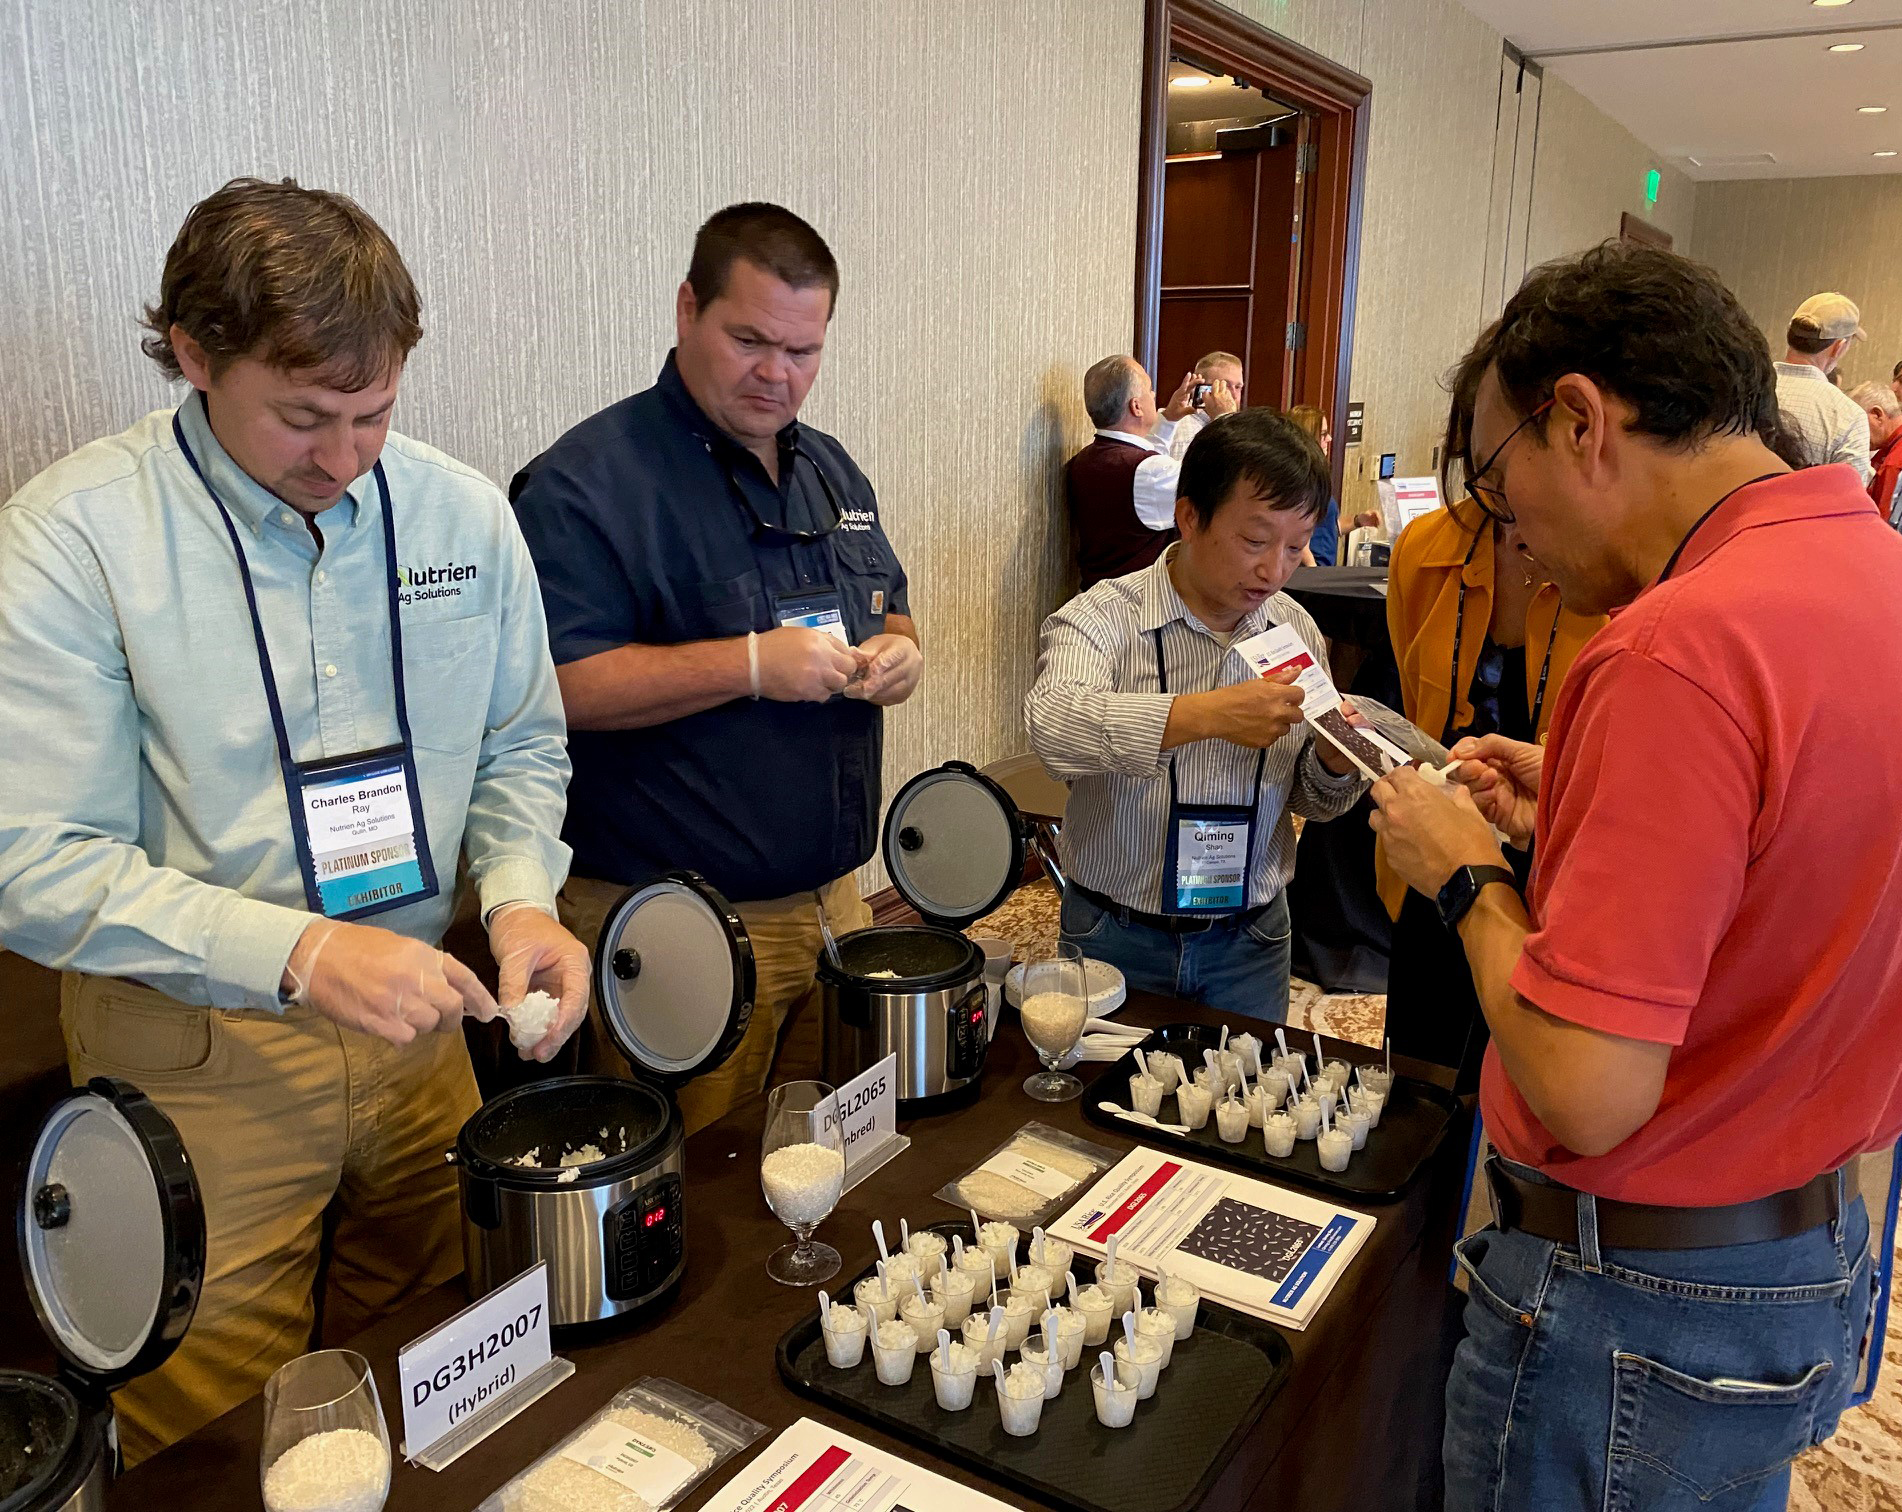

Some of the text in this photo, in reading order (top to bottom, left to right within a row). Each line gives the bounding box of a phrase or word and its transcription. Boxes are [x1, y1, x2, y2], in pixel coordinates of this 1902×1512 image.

[398, 586, 462, 605] Ag Solutions
[311, 783, 402, 809] Charles Brandon
[352, 804, 370, 814] Ray
[330, 823, 355, 832] Nutrien
[367, 813, 396, 825] Solutions
[1194, 831, 1234, 842] Qiming
[322, 843, 411, 875] PLATINUM SPONSOR
[1181, 873, 1241, 885] PLATINUM SPONSOR
[347, 882, 403, 907] EXHIBITOR
[1192, 896, 1229, 906] EXHIBITOR
[1127, 1192, 1147, 1210] DGL2065
[413, 1303, 542, 1408] DG3H2007
[448, 1363, 515, 1425] (Hybrid)
[741, 1484, 766, 1505] Quality
[762, 1453, 799, 1485] Symposium
